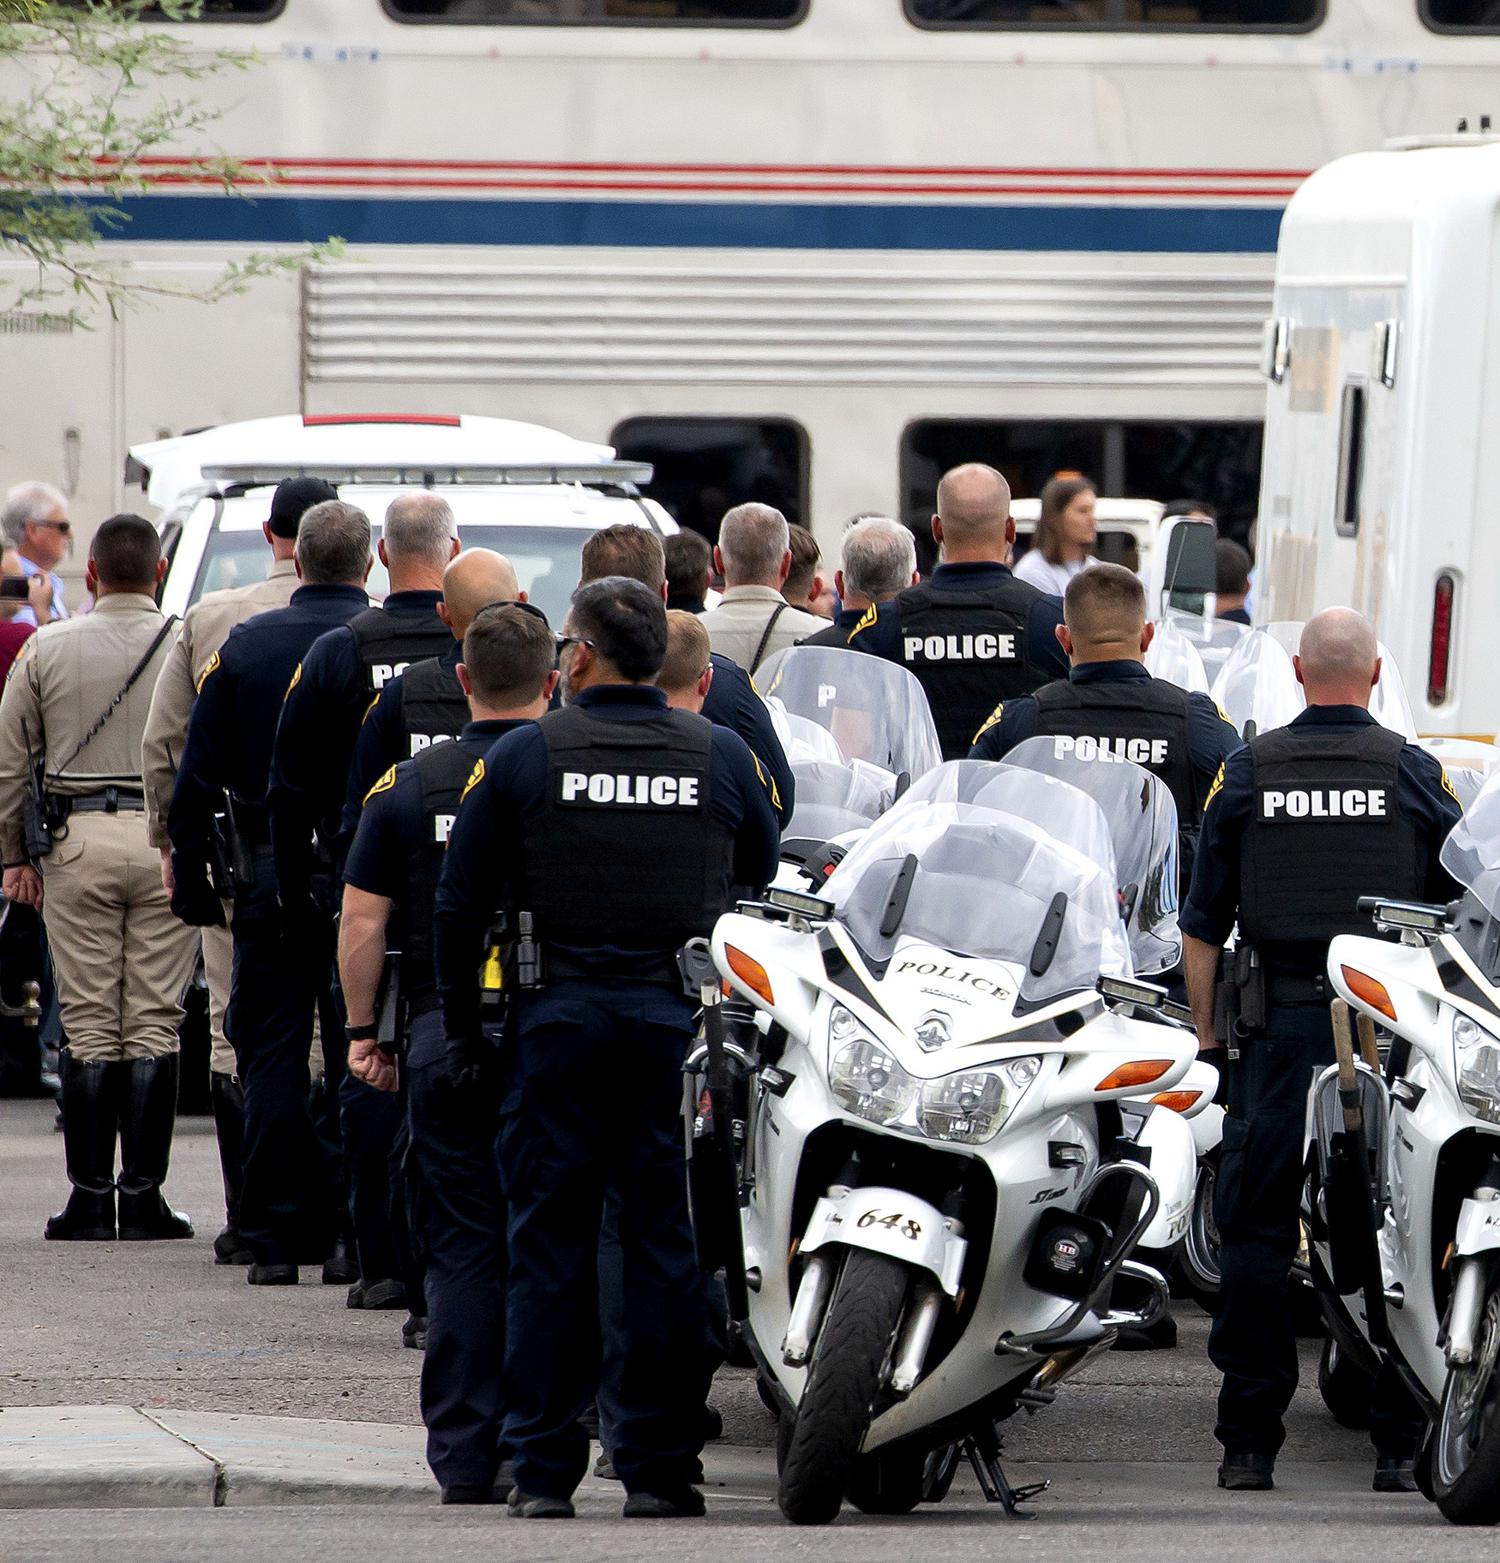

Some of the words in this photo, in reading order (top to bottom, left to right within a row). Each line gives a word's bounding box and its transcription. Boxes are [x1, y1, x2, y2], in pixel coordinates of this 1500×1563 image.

[903, 633, 1016, 661] POLICE
[1053, 734, 1168, 764] POLICE
[561, 772, 699, 806] POLICE
[1263, 789, 1386, 818] POLICE
[896, 961, 1011, 1001] POLICE
[856, 1208, 922, 1241] 648
